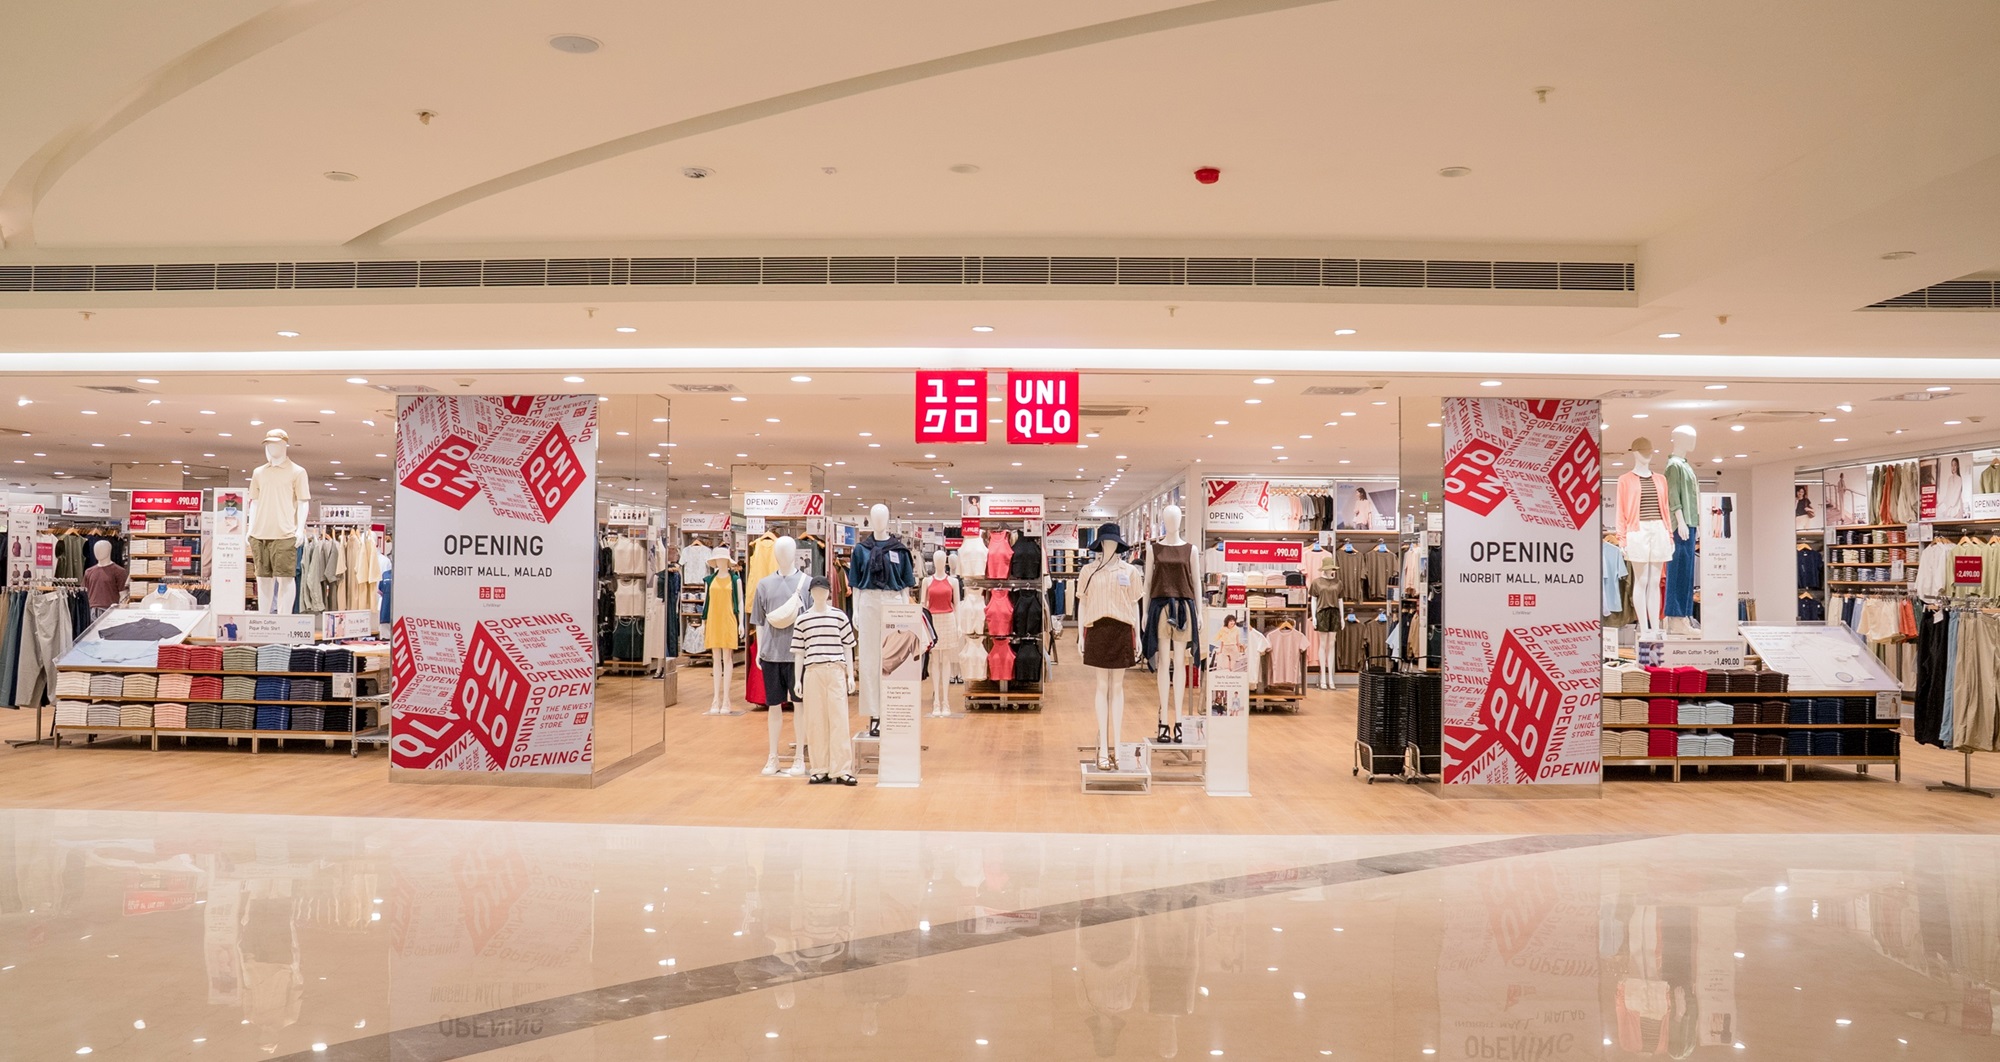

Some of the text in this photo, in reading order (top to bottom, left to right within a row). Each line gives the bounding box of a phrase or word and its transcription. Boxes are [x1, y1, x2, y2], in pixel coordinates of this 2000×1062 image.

[925, 379, 978, 403] ユニ
[1015, 380, 1066, 405] UNI
[923, 409, 978, 433] クロ
[1015, 409, 1071, 438] QLO
[746, 498, 779, 506] OPENING
[1209, 511, 1244, 520] OPENING
[444, 534, 544, 556] OPENING
[1470, 541, 1574, 563] OPENING
[434, 566, 553, 578] INORBIT MALL, MALAD
[1460, 573, 1584, 585] INORBIT MALL, MALAD
[416, 618, 462, 631] OPENING
[501, 612, 574, 629] OPENING
[530, 628, 561, 636] NEWEST
[1561, 635, 1593, 644] NEWEST
[484, 619, 534, 671] OPENING
[1513, 628, 1565, 679] OPENING
[1554, 650, 1579, 658] STORE
[473, 639, 518, 712] UNI
[1502, 647, 1549, 721] UNI
[548, 682, 592, 698] OPEN
[462, 678, 507, 748] QLO
[514, 686, 546, 753] OPENING
[543, 713, 569, 721] UNIQLO
[540, 721, 563, 729] STORE
[1490, 688, 1539, 758] QLO
[1545, 695, 1577, 762] OPENING
[1571, 730, 1595, 738] STORE
[510, 750, 579, 768] OPENING
[1540, 760, 1600, 779] OPENIN
